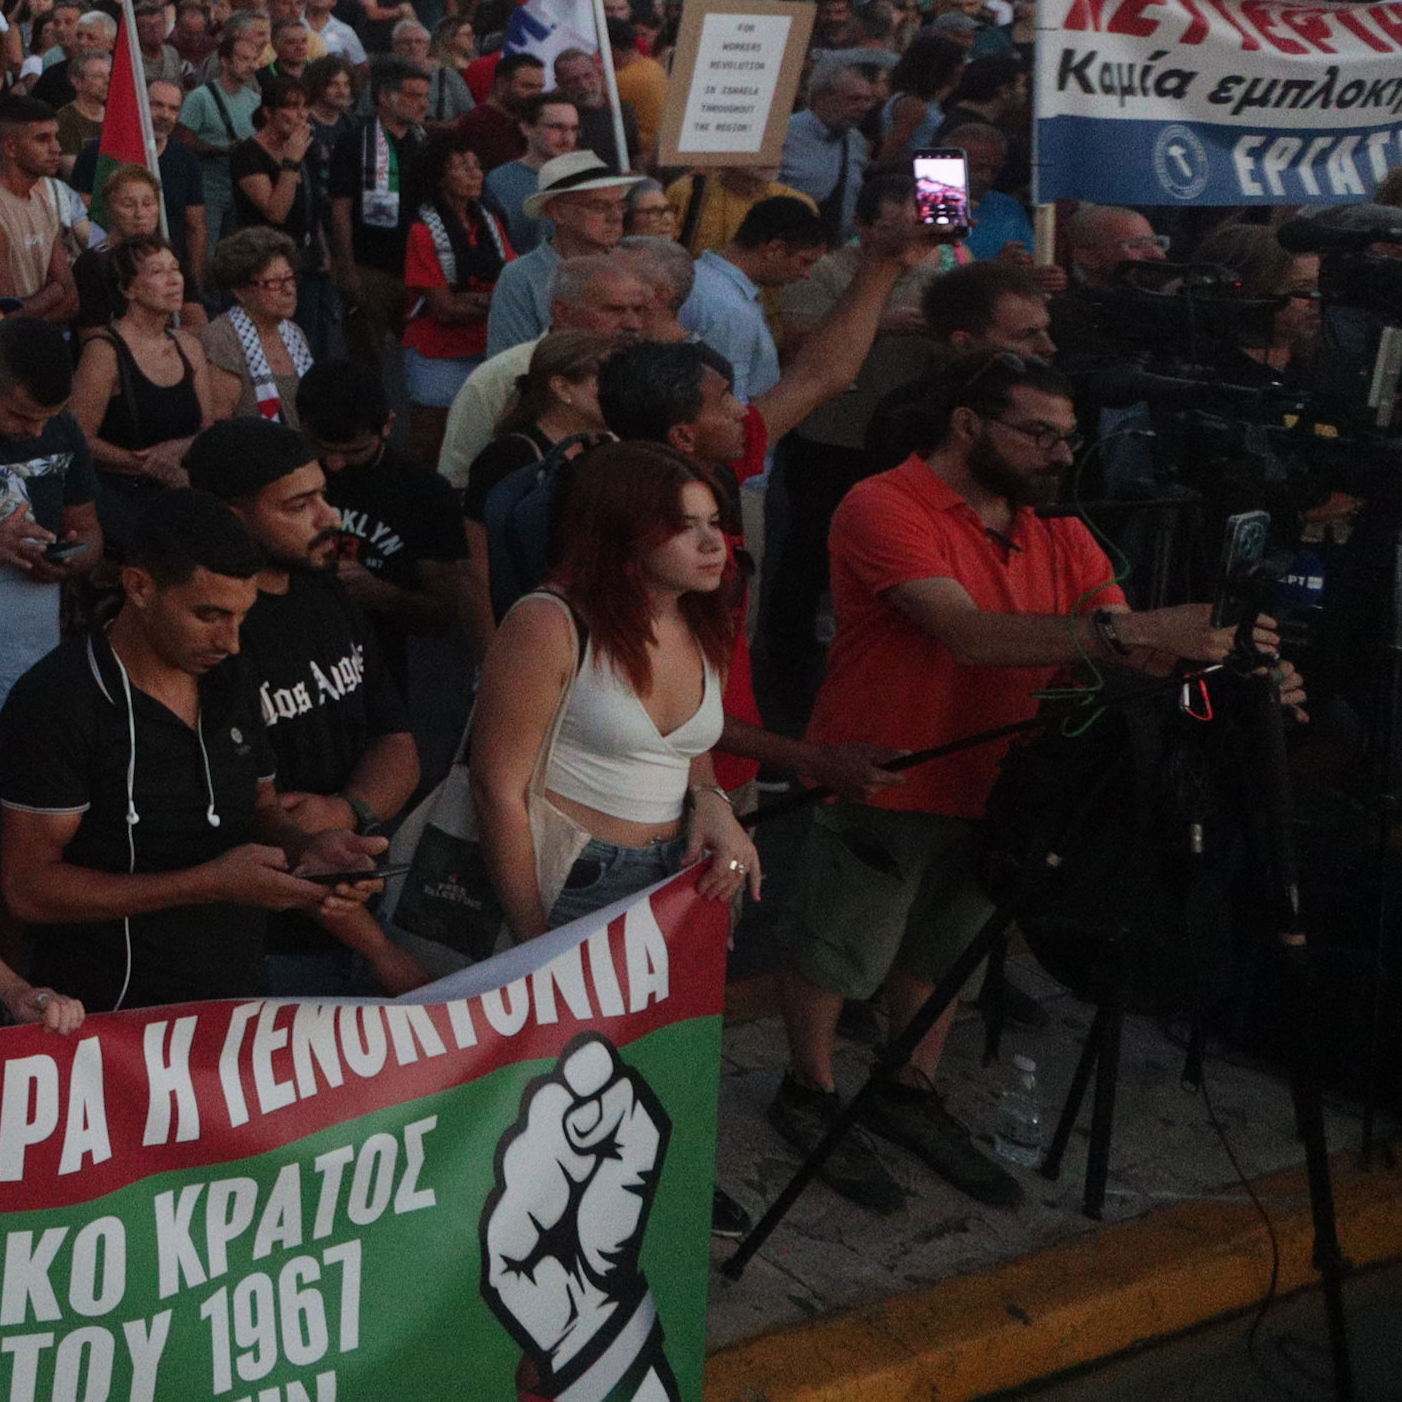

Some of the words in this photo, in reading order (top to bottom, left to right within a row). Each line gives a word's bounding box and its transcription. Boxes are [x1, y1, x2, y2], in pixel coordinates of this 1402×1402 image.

[722, 42, 762, 51] WORKERS
[737, 23, 756, 32] FOR
[710, 61, 766, 70] REVOLUTION
[1058, 49, 1198, 107] Καμία
[700, 104, 756, 114] THROUGHOUT
[1232, 130, 1402, 196] ΕΡΓΑΤ
[141, 1013, 202, 1148] Η
[154, 1115, 438, 1302] ΚΡΑΤΟΣ
[1, 1308, 173, 1402] ΤΟΥ
[199, 1237, 363, 1397] 1967
